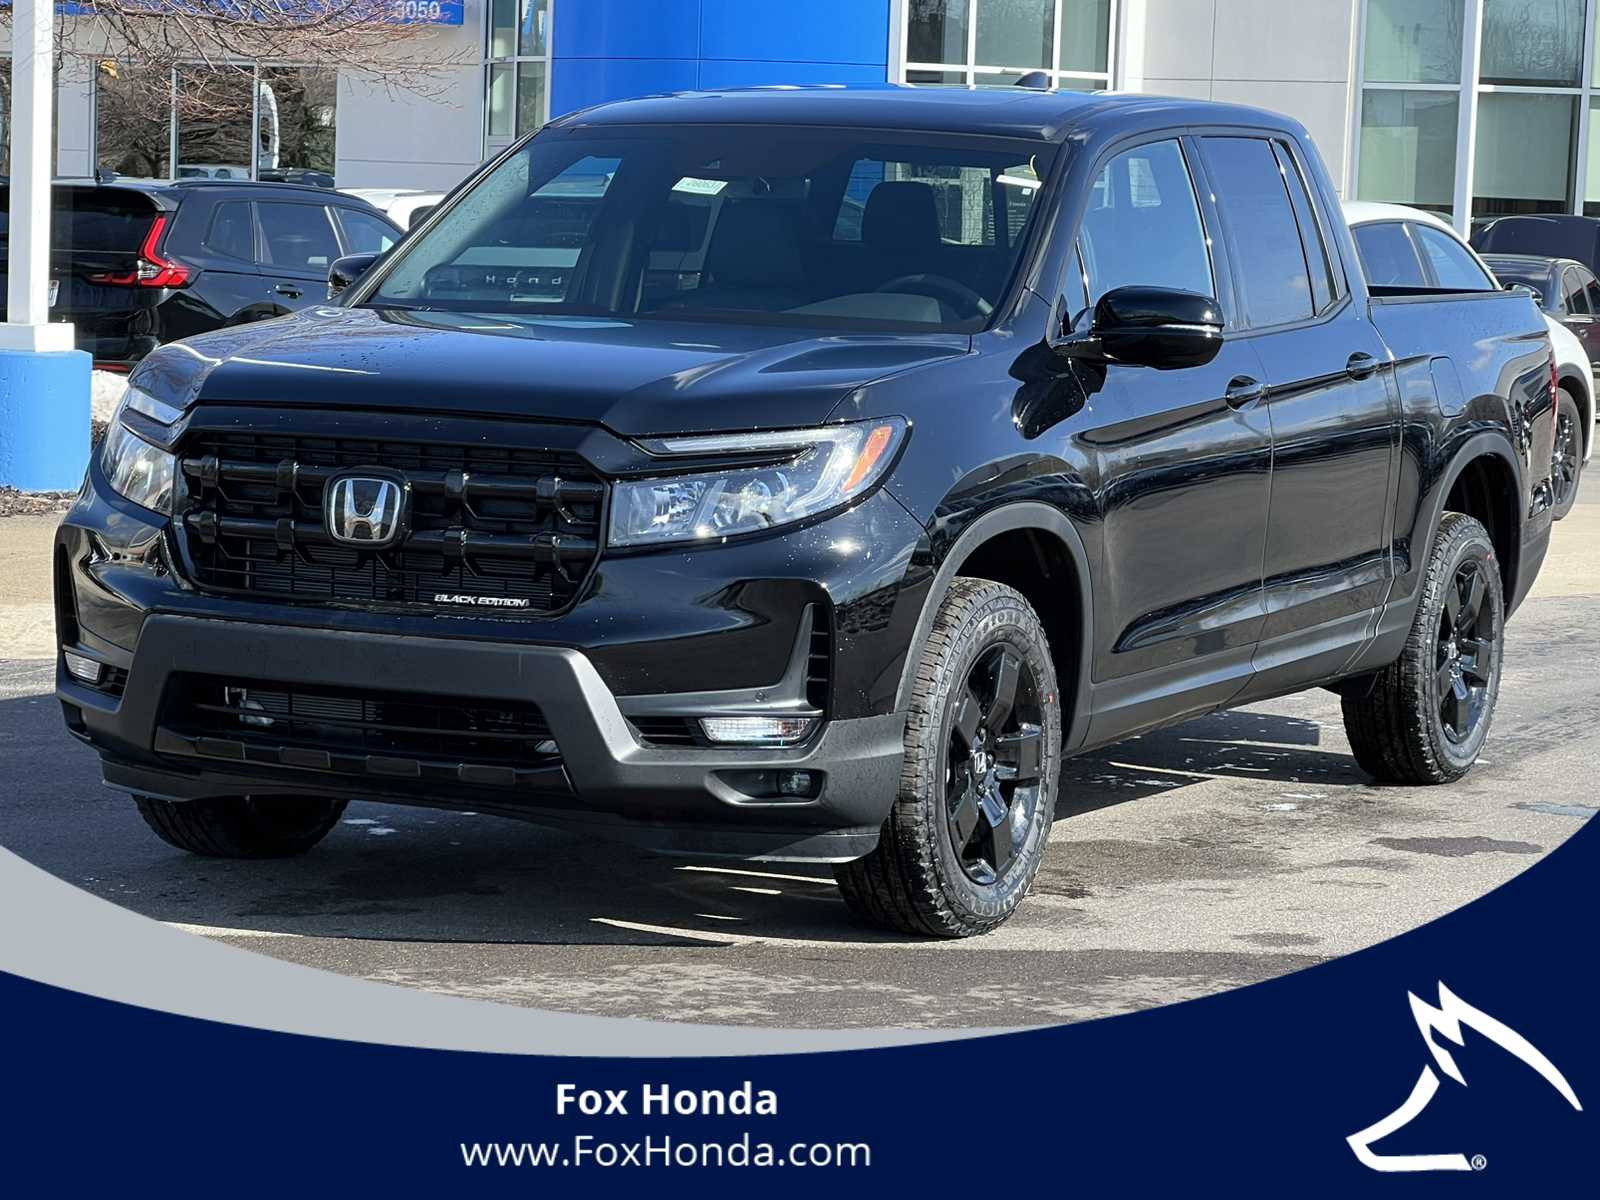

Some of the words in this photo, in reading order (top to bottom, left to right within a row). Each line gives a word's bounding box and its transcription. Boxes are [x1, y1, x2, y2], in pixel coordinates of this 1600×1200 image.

[485, 274, 562, 285] Hond
[434, 594, 477, 605] BLACK
[477, 597, 530, 607] EDITION
